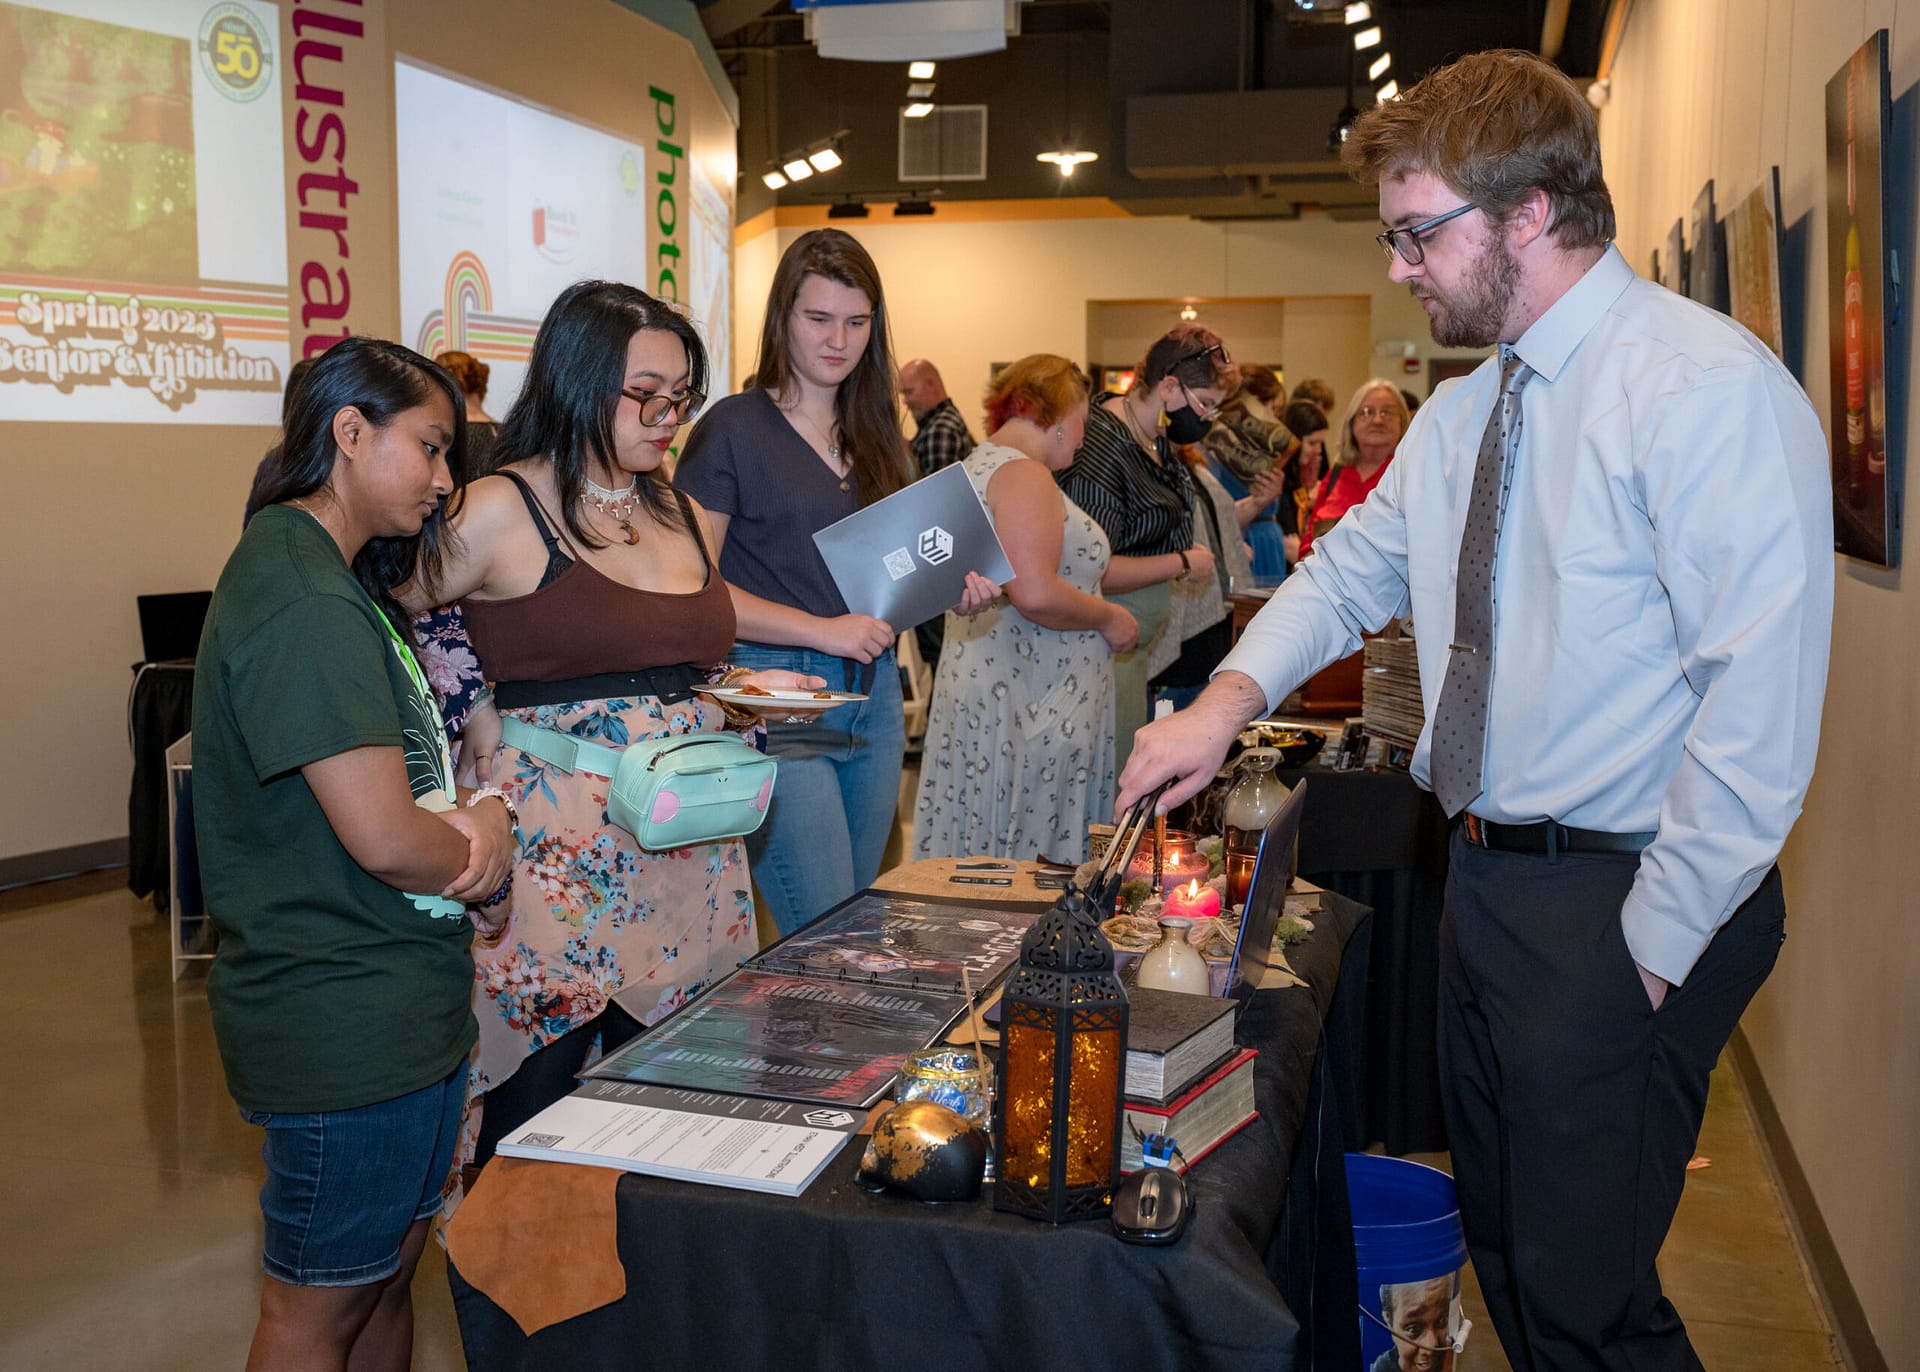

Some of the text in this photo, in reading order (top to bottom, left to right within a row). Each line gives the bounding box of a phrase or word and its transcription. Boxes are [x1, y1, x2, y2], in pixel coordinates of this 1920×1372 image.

[216, 32, 259, 79] 50
[292, 0, 364, 361] lustrat
[16, 291, 217, 346] Spring 2023
[114, 342, 275, 400] Exhibition
